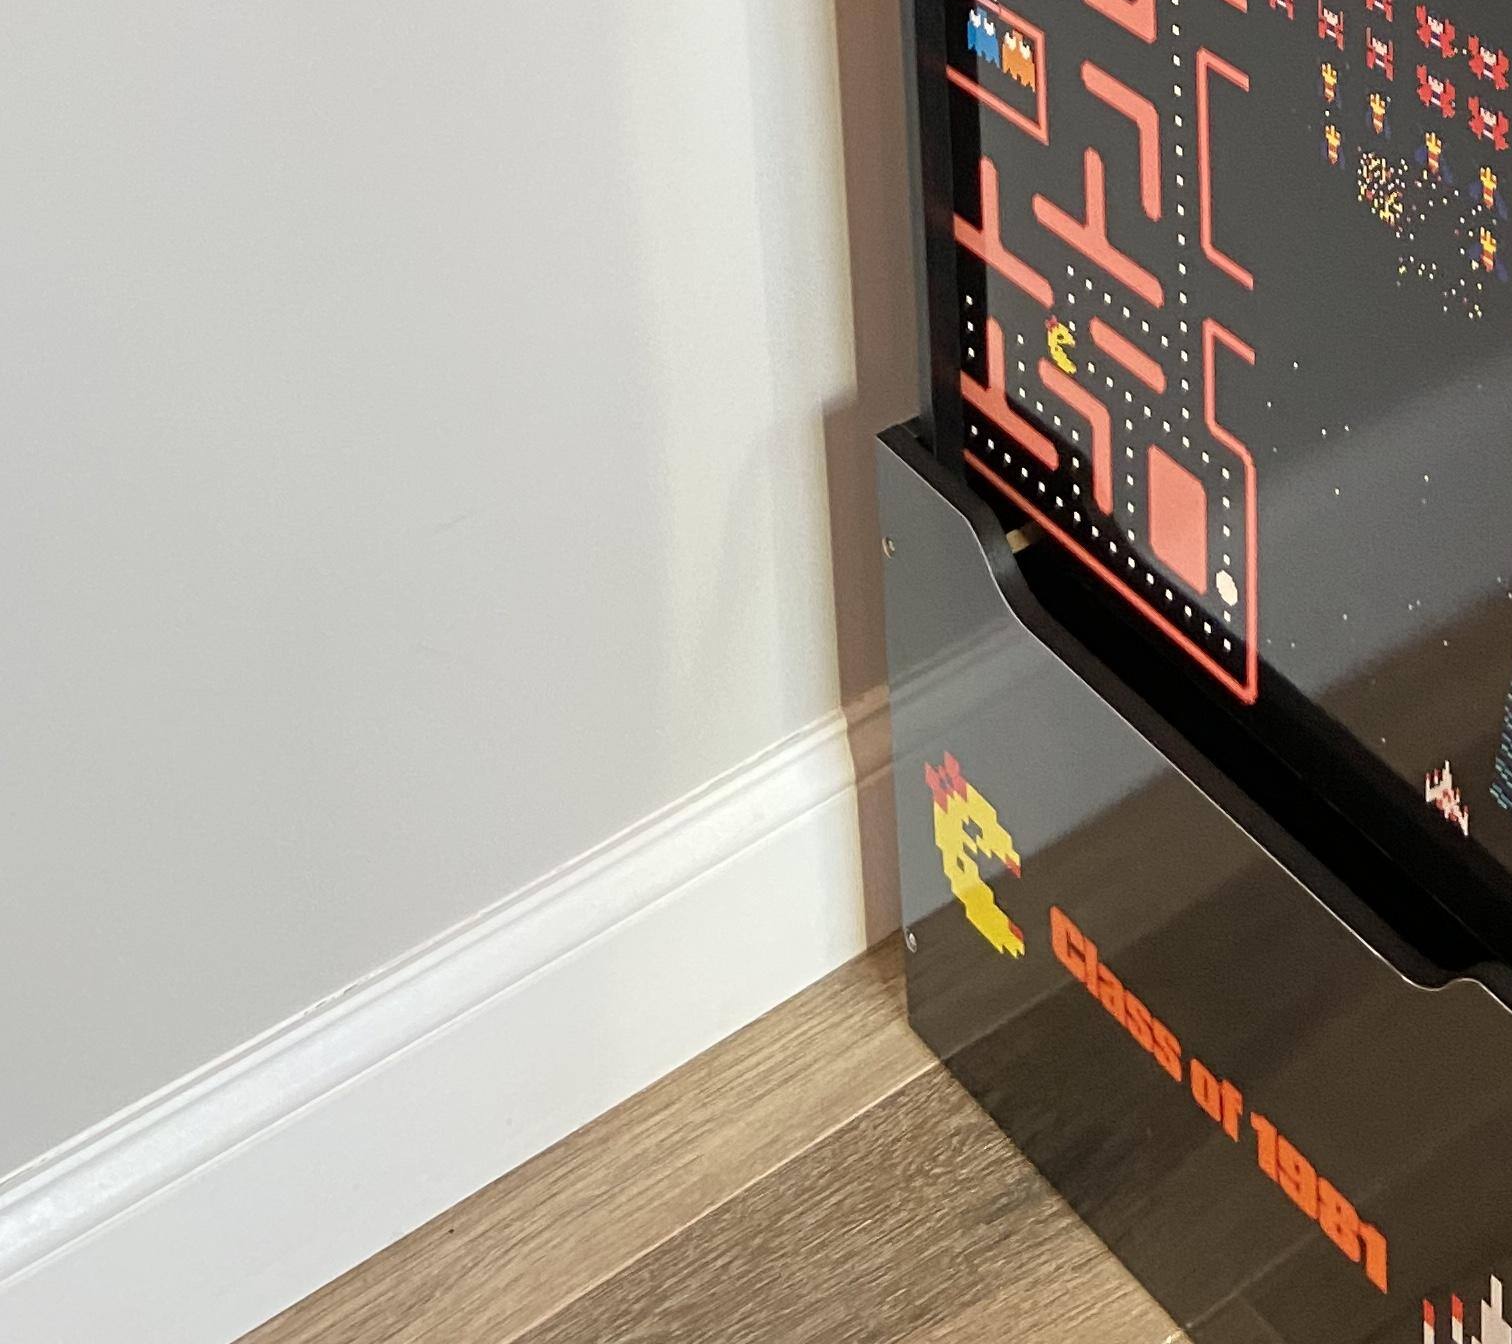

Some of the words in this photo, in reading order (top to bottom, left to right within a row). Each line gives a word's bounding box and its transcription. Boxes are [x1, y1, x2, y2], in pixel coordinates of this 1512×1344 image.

[1049, 904, 1183, 1083] Class
[1189, 1057, 1244, 1143] of
[1249, 1111, 1389, 1295] 1981
